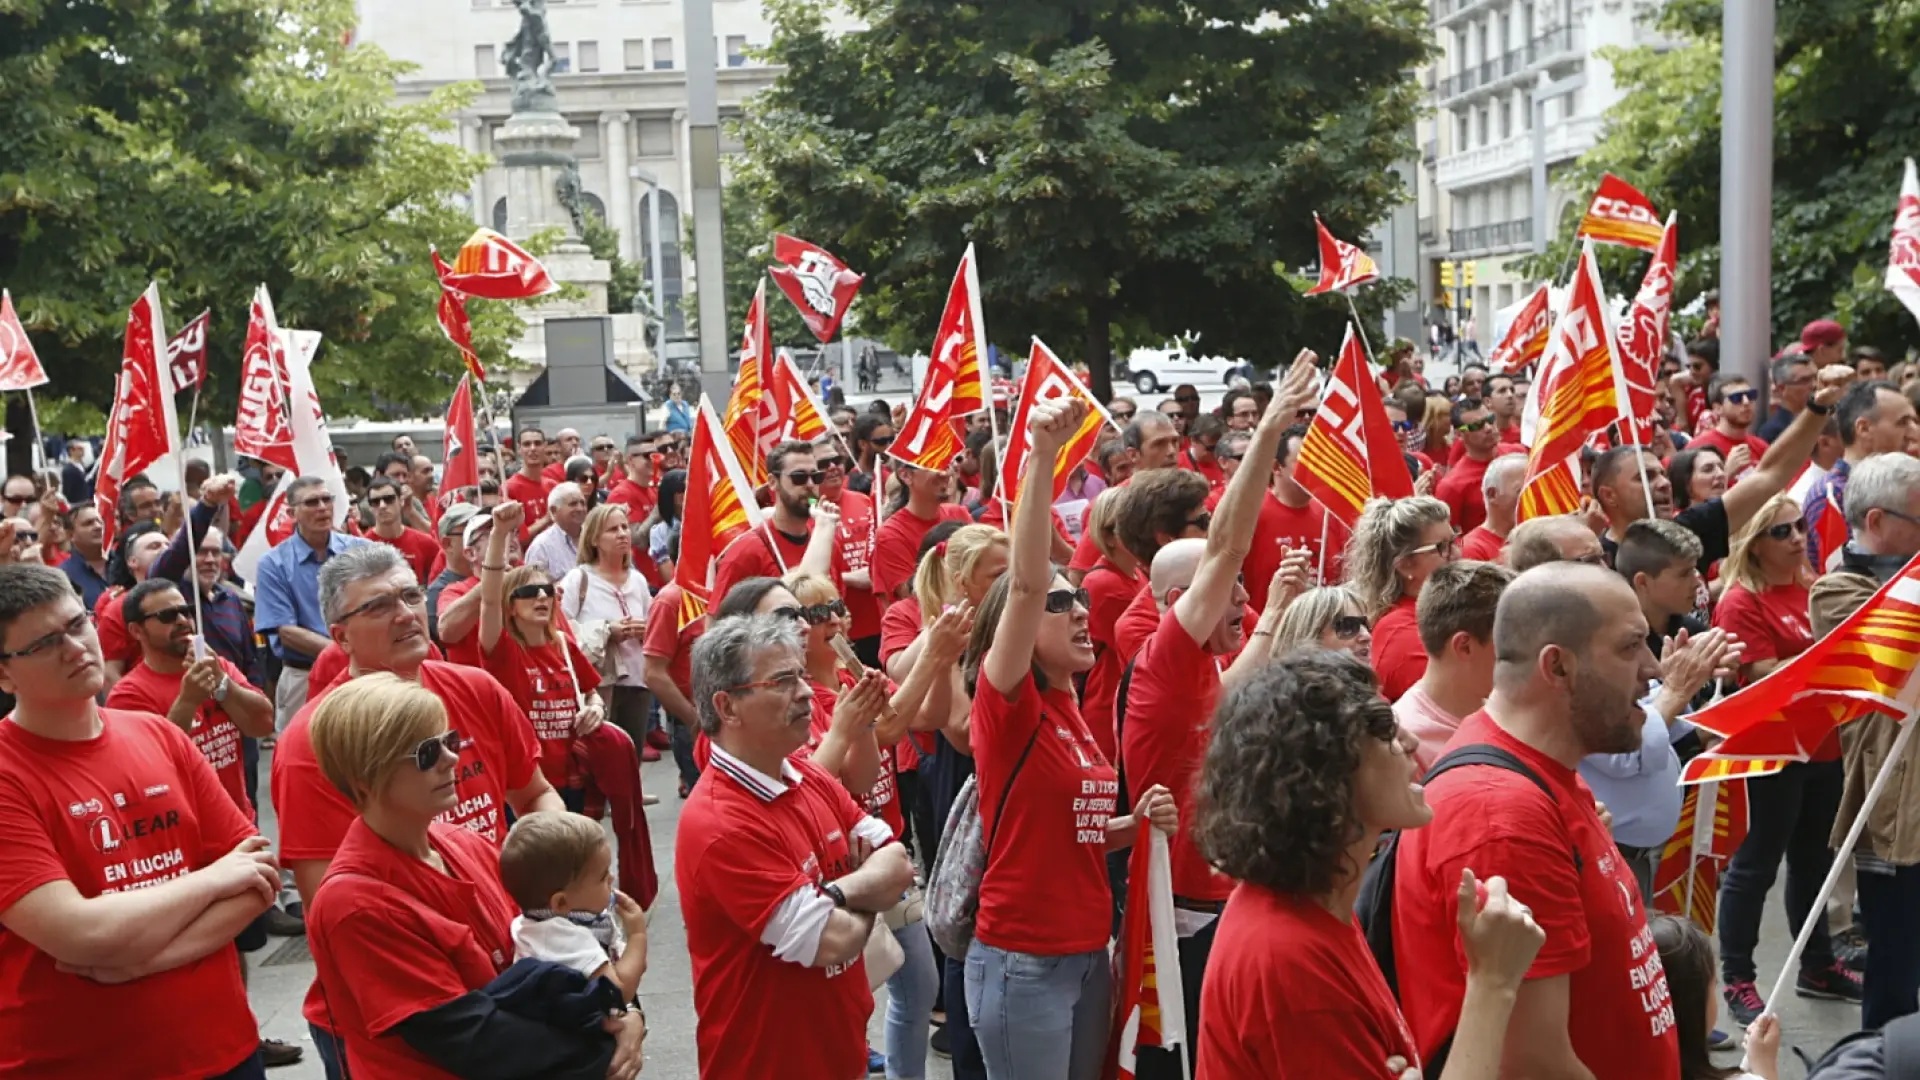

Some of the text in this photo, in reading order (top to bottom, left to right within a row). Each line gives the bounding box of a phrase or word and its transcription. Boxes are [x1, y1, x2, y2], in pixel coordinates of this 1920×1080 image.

[238, 352, 276, 437] UGT
[445, 792, 493, 823] LUCHA
[123, 809, 180, 842] LEAR
[104, 847, 184, 883] EN LUCHA
